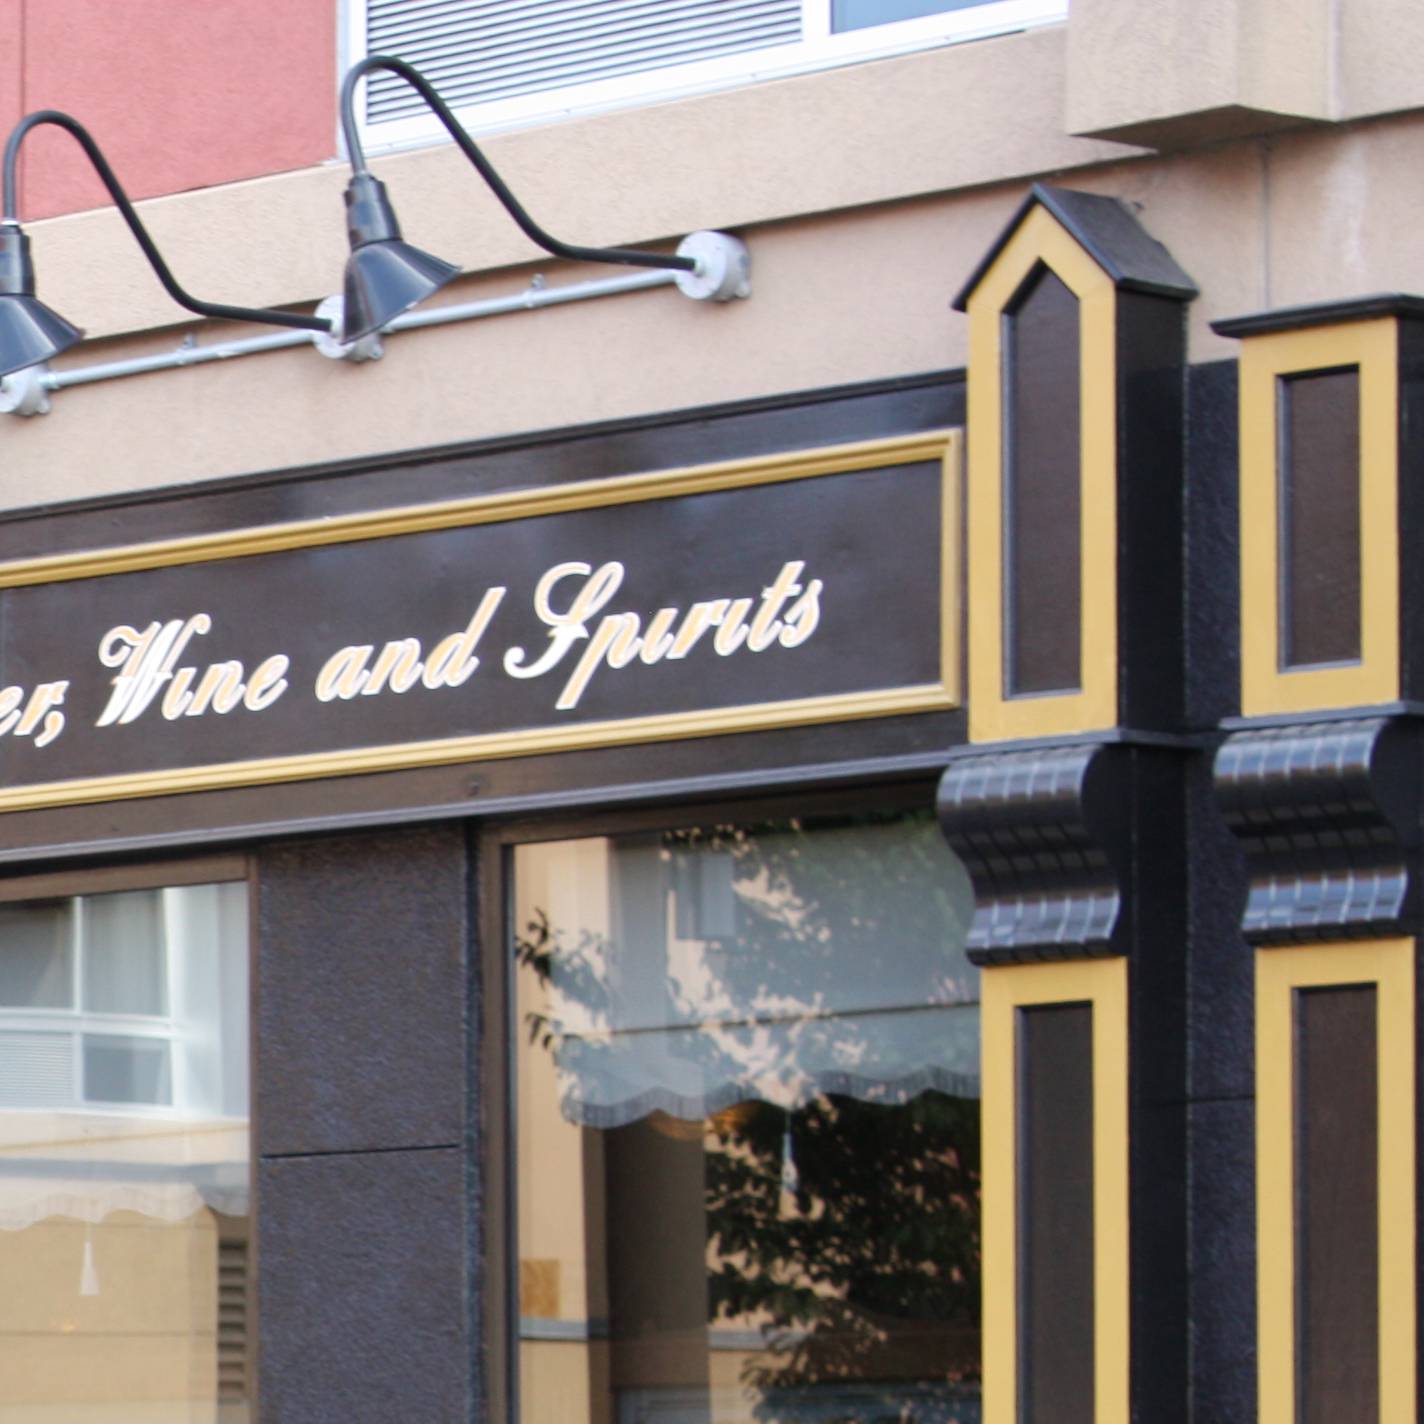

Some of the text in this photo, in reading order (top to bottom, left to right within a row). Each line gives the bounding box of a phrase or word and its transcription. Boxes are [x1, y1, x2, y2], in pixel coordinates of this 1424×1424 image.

[94, 612, 289, 728] Wine
[314, 585, 507, 703] and
[502, 560, 825, 711] Spirits
